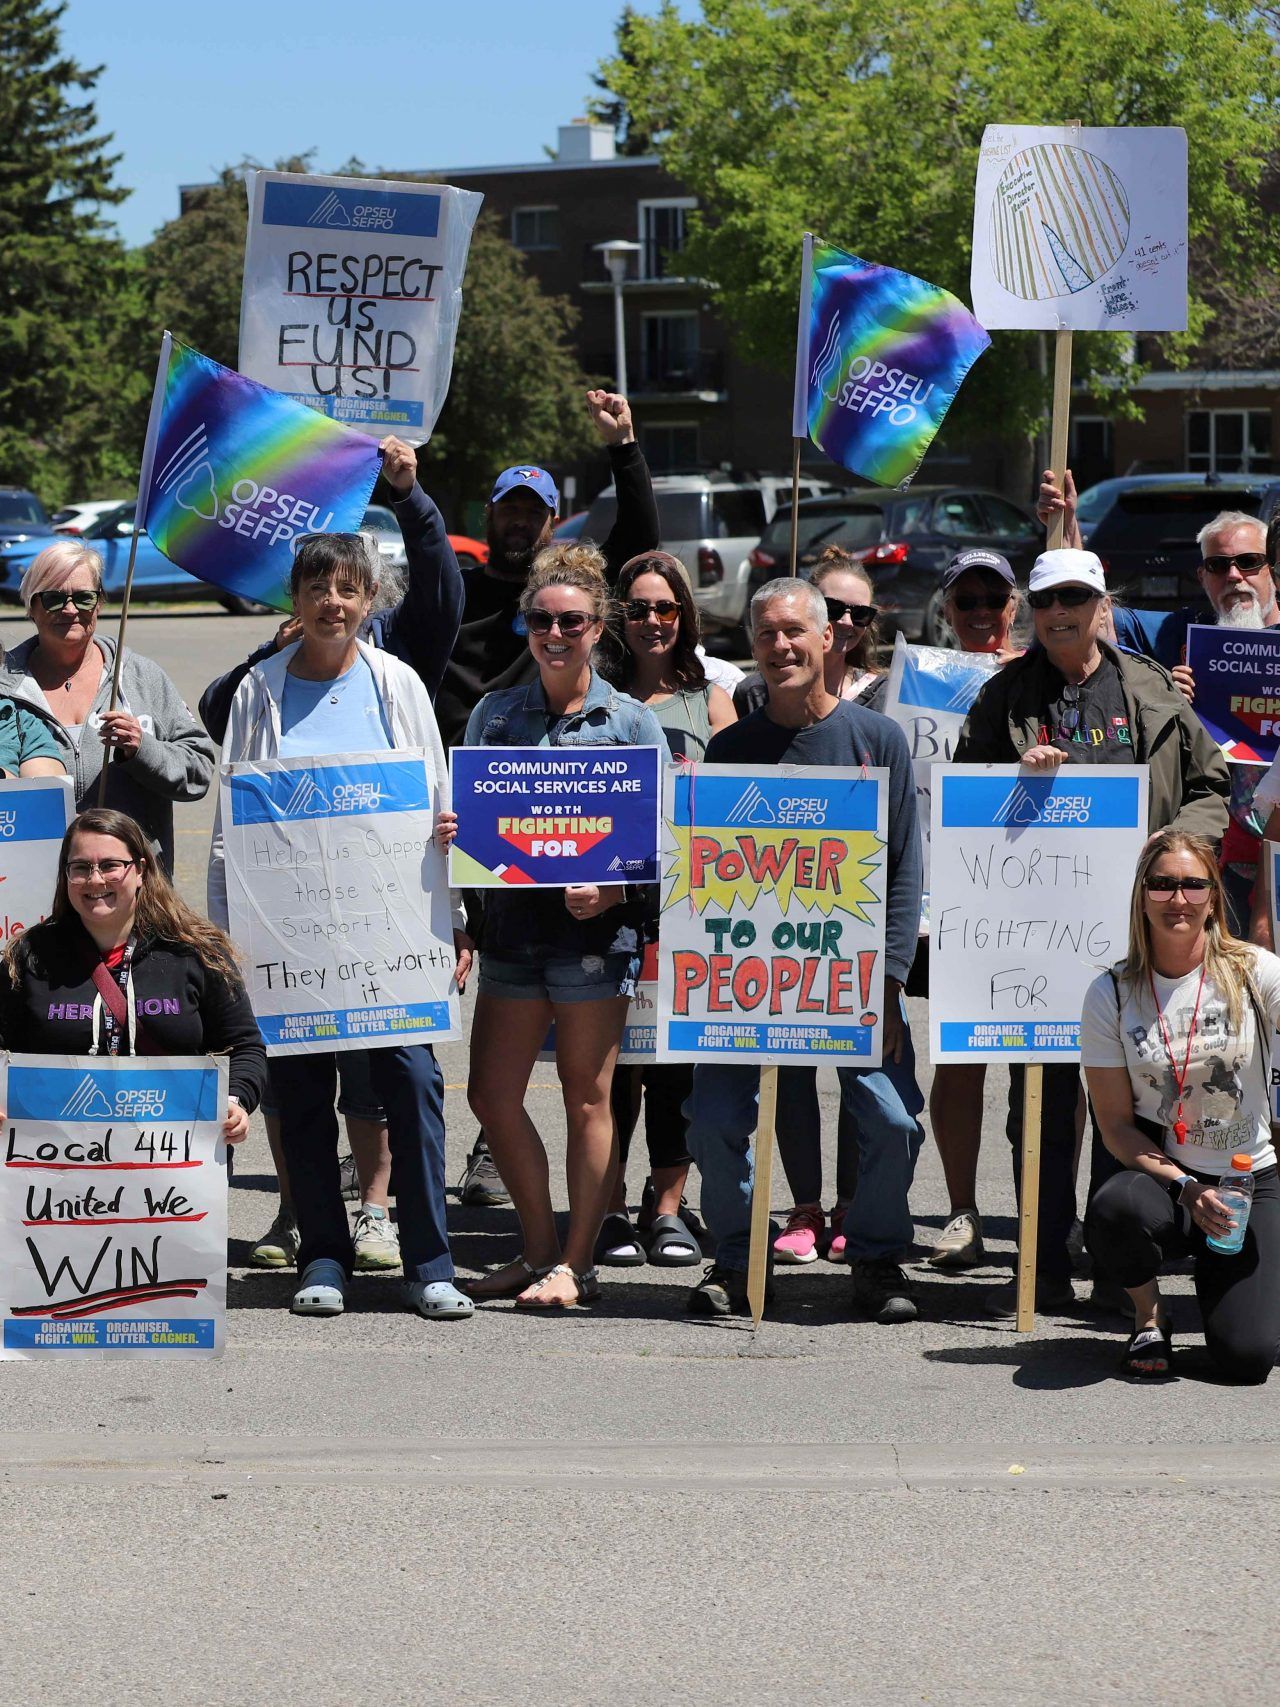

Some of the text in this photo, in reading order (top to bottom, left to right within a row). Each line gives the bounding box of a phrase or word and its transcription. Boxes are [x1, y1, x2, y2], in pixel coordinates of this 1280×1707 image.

[999, 168, 1033, 196] Executive
[1007, 182, 1036, 205] Director
[353, 205, 397, 219] OPSEU
[351, 216, 394, 230] SEFPO
[288, 250, 443, 298] RESPECT
[327, 297, 377, 332] US
[278, 324, 417, 369] FUND
[311, 365, 391, 400] US!
[848, 355, 935, 404] OPSEU
[333, 397, 389, 411] ORGANISER.
[838, 381, 917, 426] SEFPO
[333, 407, 411, 423] LUTTER. GAGNER.
[231, 479, 334, 534] OPSEU
[1208, 659, 1262, 675] SOCIAL
[488, 761, 628, 775] COMMUNITY AND
[333, 783, 381, 799] OPSEU
[473, 779, 642, 794] SOCIAL SERVICES ARE
[332, 797, 380, 812] SEFPO
[531, 805, 582, 815] WORTH
[777, 797, 828, 812] OPSEU
[1044, 796, 1091, 810] OPSEU
[776, 810, 826, 825] SEFPO
[1042, 809, 1090, 823] SEFPO
[498, 816, 613, 835] FIGHTING
[253, 839, 351, 872] Help us
[531, 840, 579, 857] FOR
[690, 835, 848, 895] POWER
[960, 844, 1093, 889] WORTH
[294, 880, 398, 903] those we
[705, 918, 843, 959] TO OUR
[938, 906, 1111, 957] FIGHTING
[256, 947, 452, 990] They are worth
[361, 981, 381, 1004] it
[672, 950, 878, 1027] PEOPLE!
[991, 968, 1048, 1010] FOR
[284, 1013, 340, 1029] ORGANIZE.
[346, 1007, 410, 1023] ORGANISER.
[279, 1024, 340, 1040] FIGHT. WIN.
[347, 1016, 436, 1034] LUTTER. GAGNER.
[703, 1025, 760, 1038] ORGANIZE.
[767, 1026, 831, 1040] ORGANISER.
[973, 1025, 1028, 1036] ORGANIZE.
[697, 1036, 760, 1049] FIGHT. WIN.
[767, 1037, 856, 1051] LUTTER. GAGNER.
[968, 1035, 1028, 1047] FIGHT. WIN.
[1034, 1035, 1074, 1047] LUTTER.
[115, 1089, 167, 1104] OPSEU
[113, 1102, 164, 1118] SEFPO
[5, 1127, 190, 1163] Local 441
[26, 1185, 194, 1222] United We
[26, 1236, 162, 1297] WIN
[41, 1321, 100, 1334] ORGANIZE.
[106, 1321, 173, 1334] ORGANISER.
[34, 1333, 99, 1345] FIGHT. WIN.
[106, 1332, 199, 1344] LUTTER. GAGNER.
